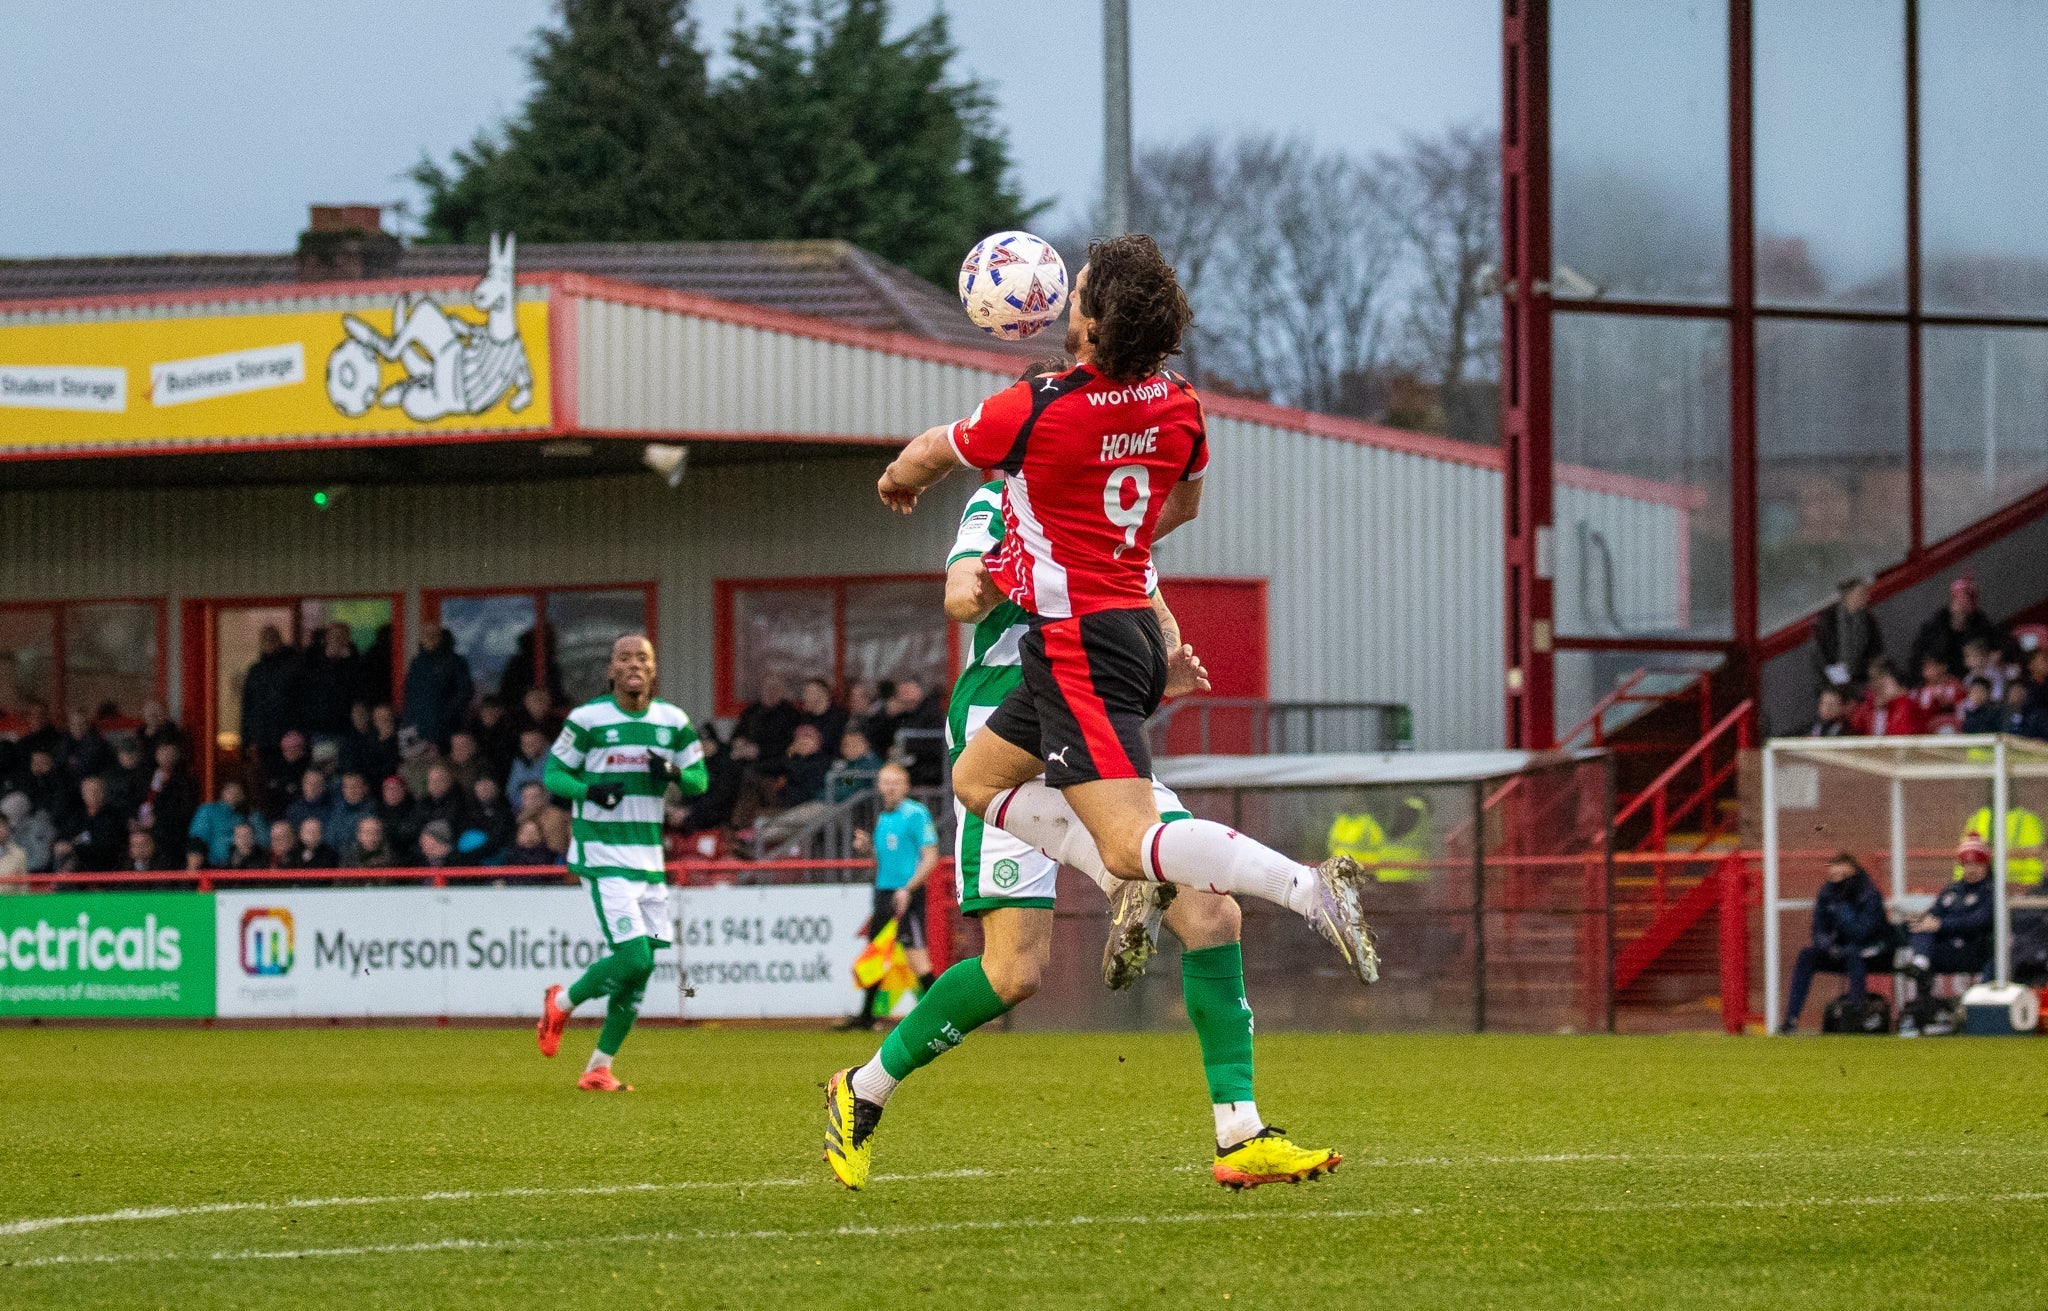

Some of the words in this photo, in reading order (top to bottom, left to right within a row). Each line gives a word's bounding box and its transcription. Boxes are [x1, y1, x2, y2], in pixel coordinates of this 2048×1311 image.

[1, 374, 56, 396] Student
[60, 375, 116, 399] Storage
[166, 366, 233, 394] Business
[236, 357, 294, 382] Storage
[1086, 382, 1168, 405] worldpay
[1100, 426, 1160, 461] HOWE
[1103, 465, 1151, 561] 9
[721, 915, 764, 946] 941
[770, 914, 833, 945] 4000
[315, 928, 458, 979] Myerson
